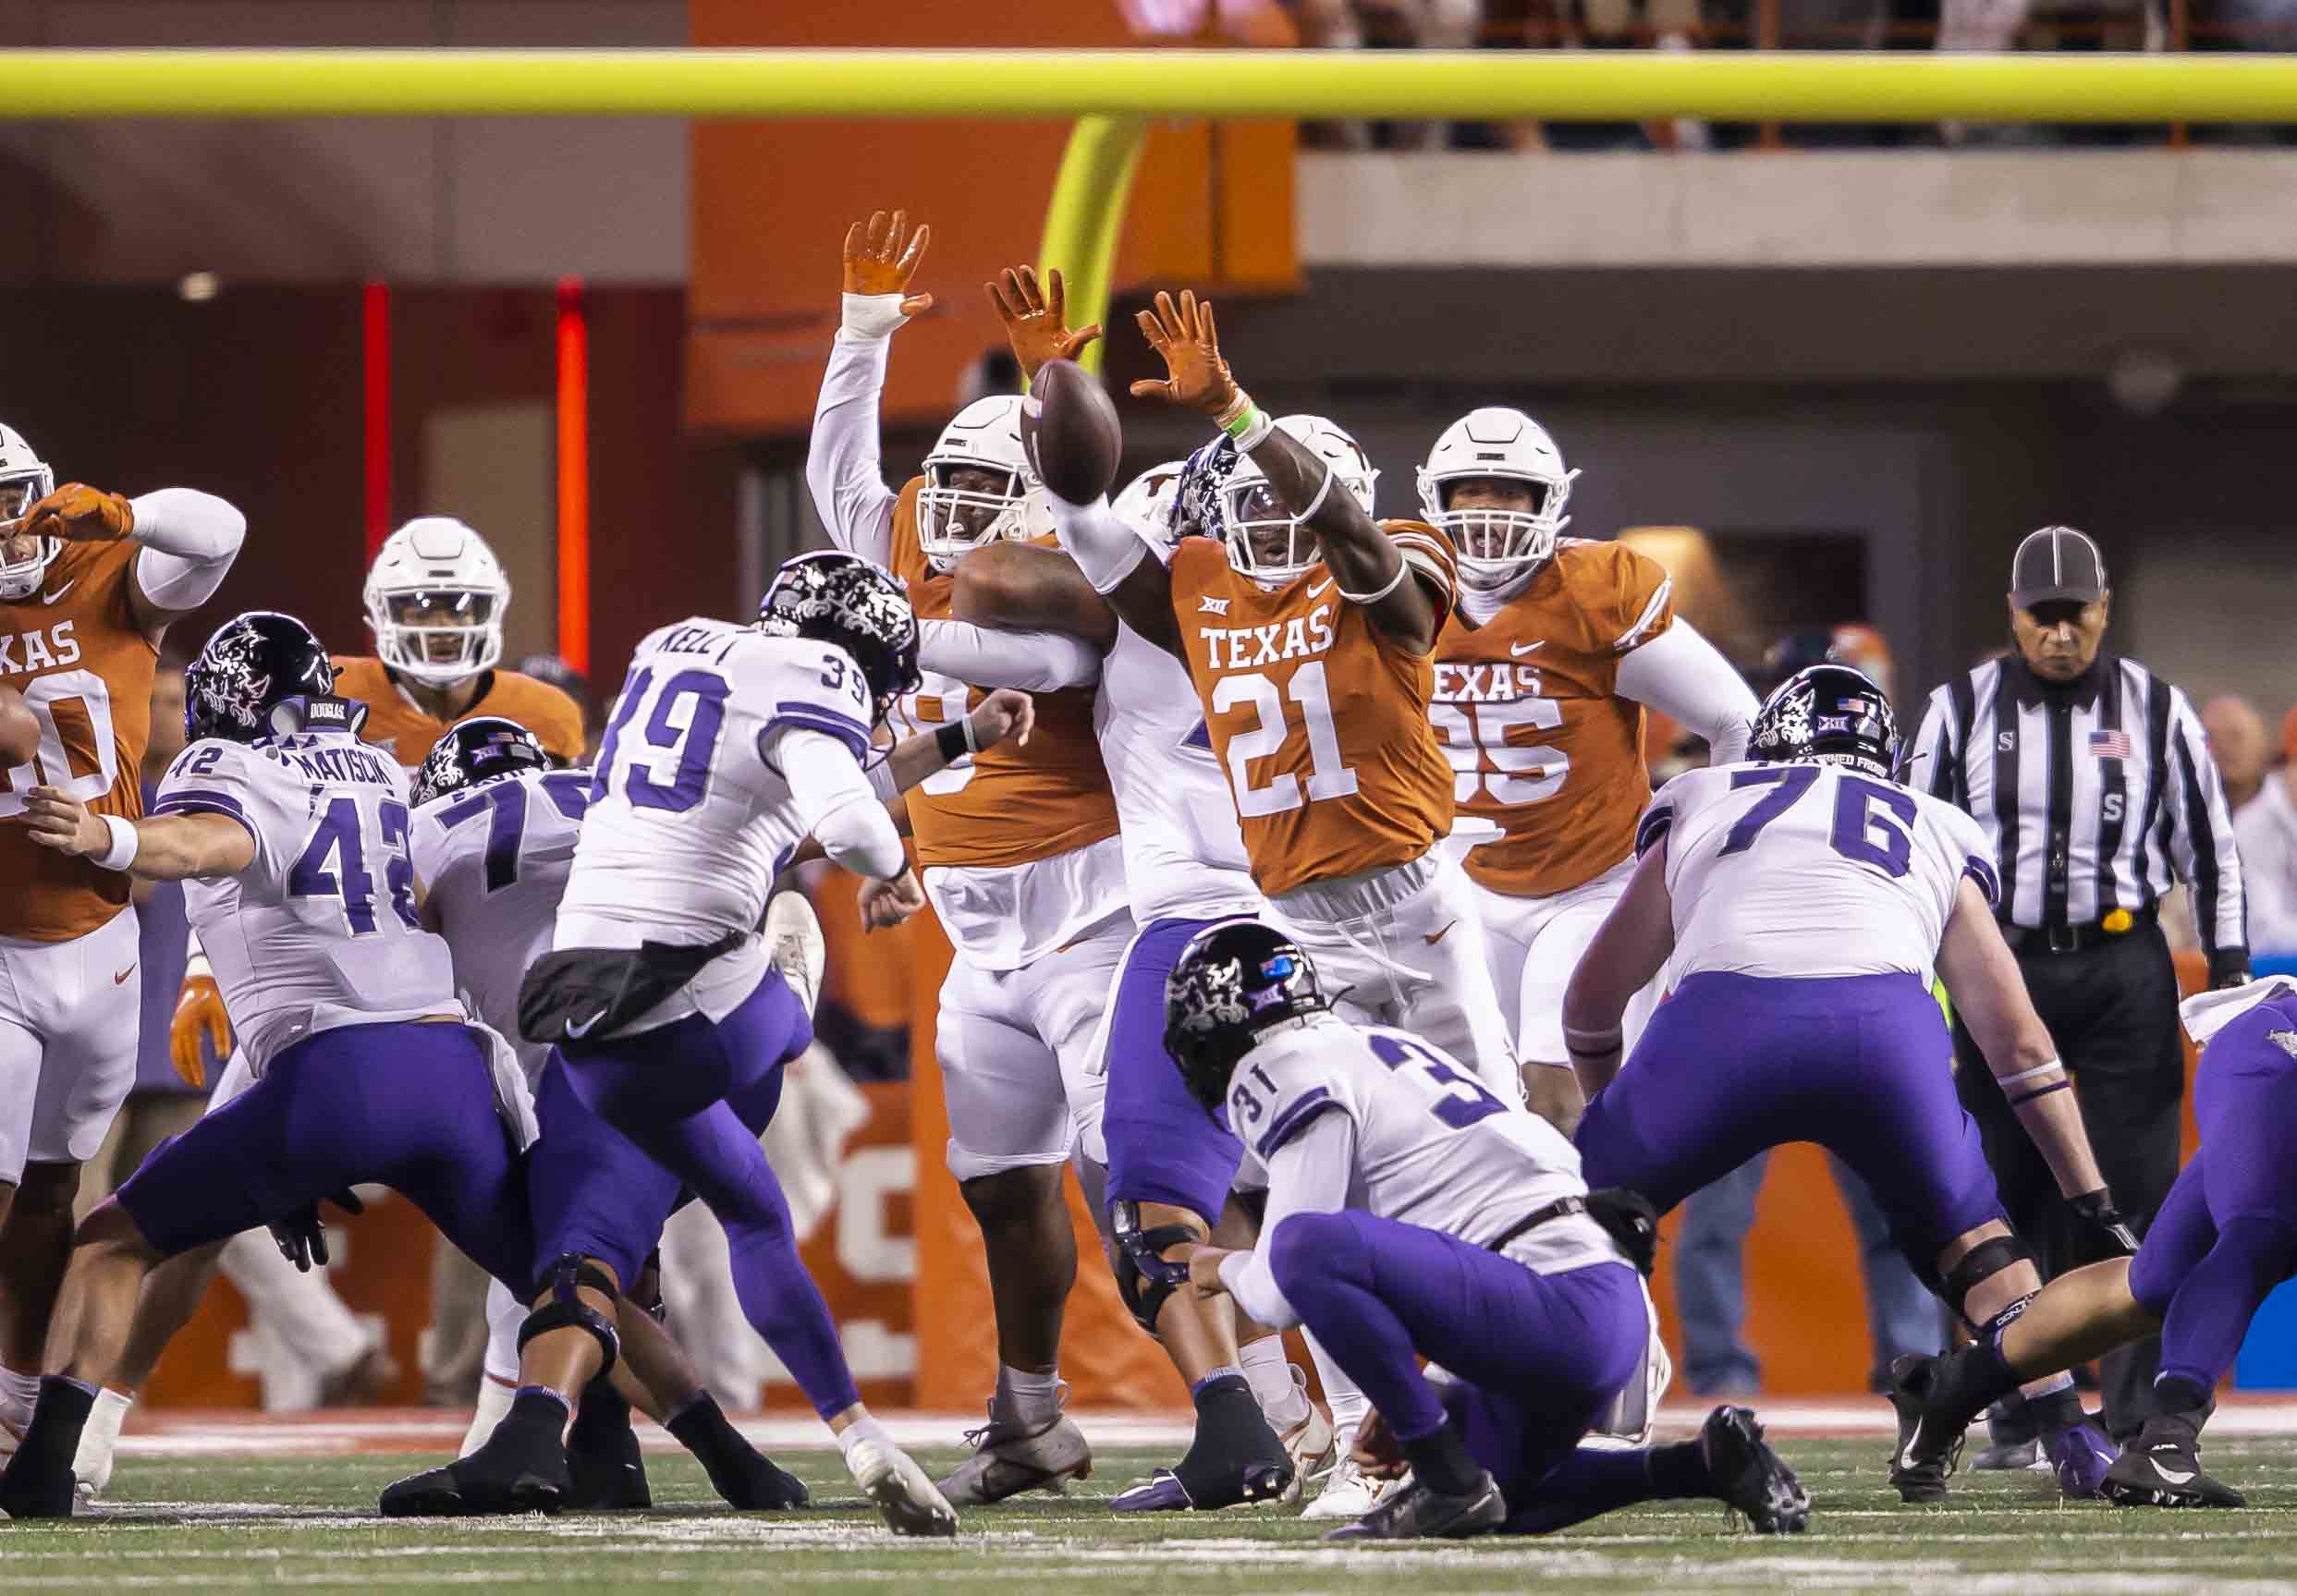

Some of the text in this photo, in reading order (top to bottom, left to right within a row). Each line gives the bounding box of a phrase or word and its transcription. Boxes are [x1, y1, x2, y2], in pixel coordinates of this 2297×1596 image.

[1200, 604, 1333, 669] TEXAS
[821, 654, 865, 708] 39
[1432, 664, 1542, 701] EXAS
[296, 748, 393, 785] MATISCIK
[1212, 661, 1358, 818] 21
[1998, 731, 2014, 751] S
[1716, 765, 1920, 879] 76
[2103, 793, 2124, 822] S
[1232, 1063, 1277, 1123] 31
